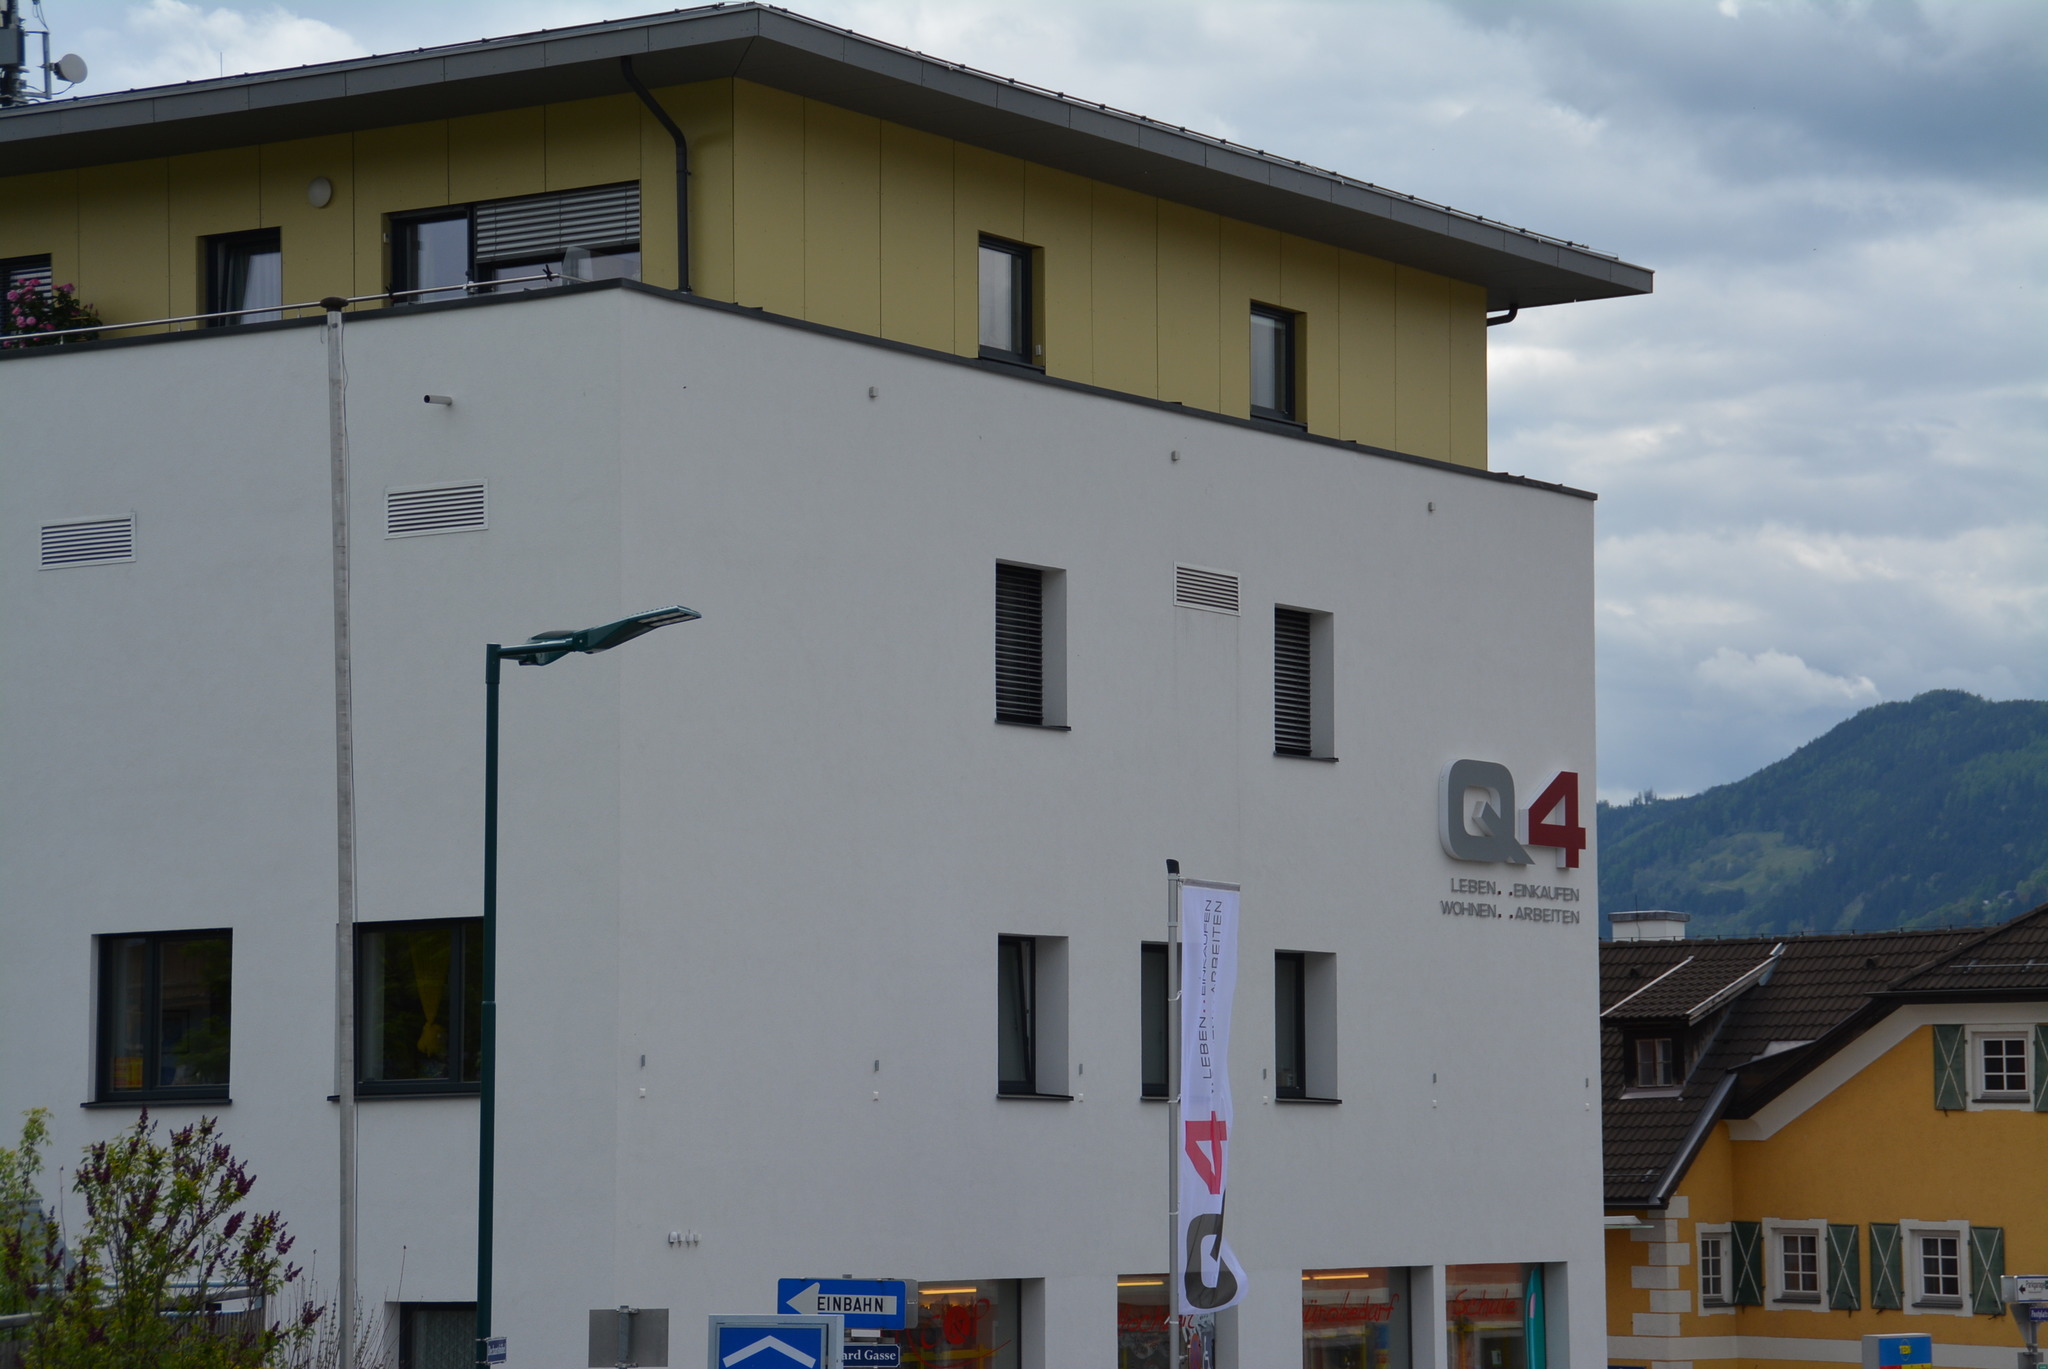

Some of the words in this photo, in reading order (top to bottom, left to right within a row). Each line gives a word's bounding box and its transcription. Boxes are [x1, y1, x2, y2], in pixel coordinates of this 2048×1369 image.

[1440, 759, 1586, 868] Q4
[817, 1296, 884, 1312] EINBAHN
[1453, 1288, 1518, 1317] Schule
[864, 1349, 896, 1360] Gasse
